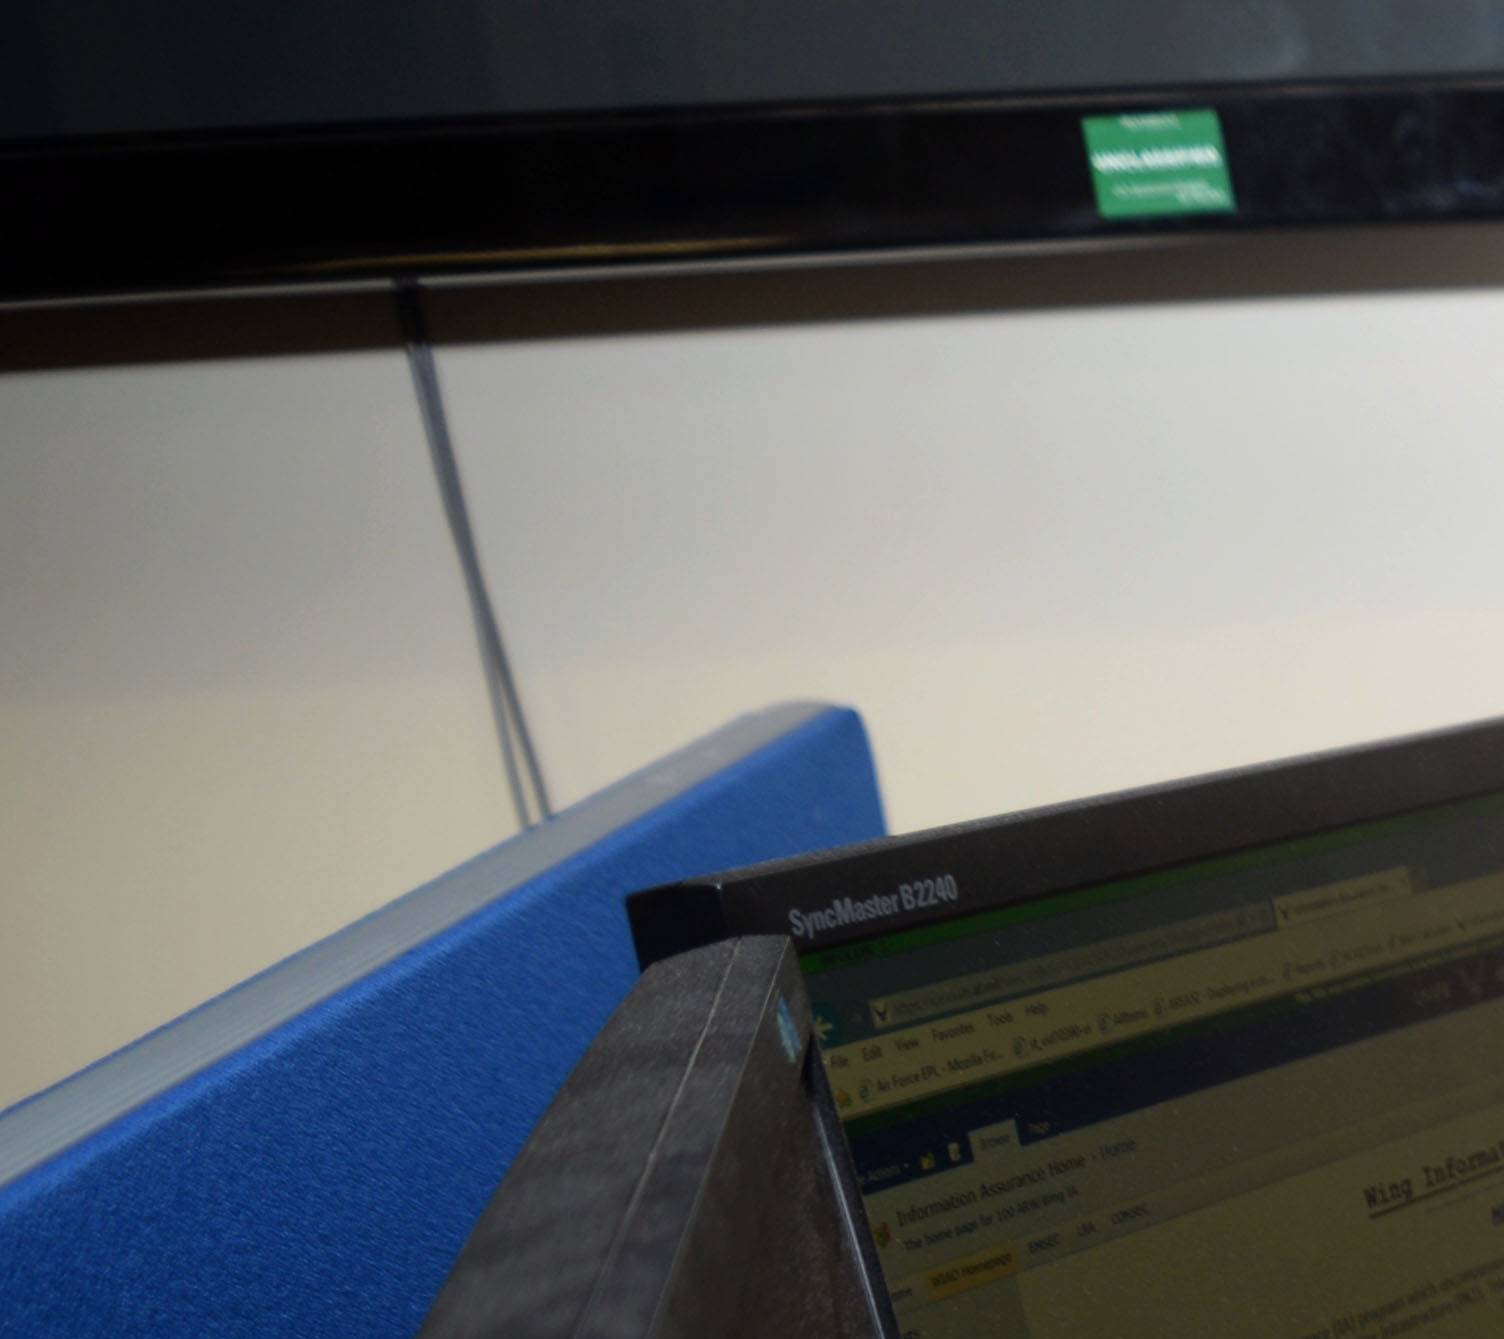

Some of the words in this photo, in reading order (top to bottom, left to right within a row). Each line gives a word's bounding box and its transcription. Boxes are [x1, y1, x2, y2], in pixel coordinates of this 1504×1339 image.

[788, 891, 898, 940] SyncMaster
[900, 873, 959, 910] B2240
[931, 1023, 976, 1042] Favorites
[895, 1190, 978, 1228] Information
[979, 1168, 1046, 1200] Assurance
[1047, 1155, 1086, 1177] Home
[1363, 1178, 1415, 1215] Wing
